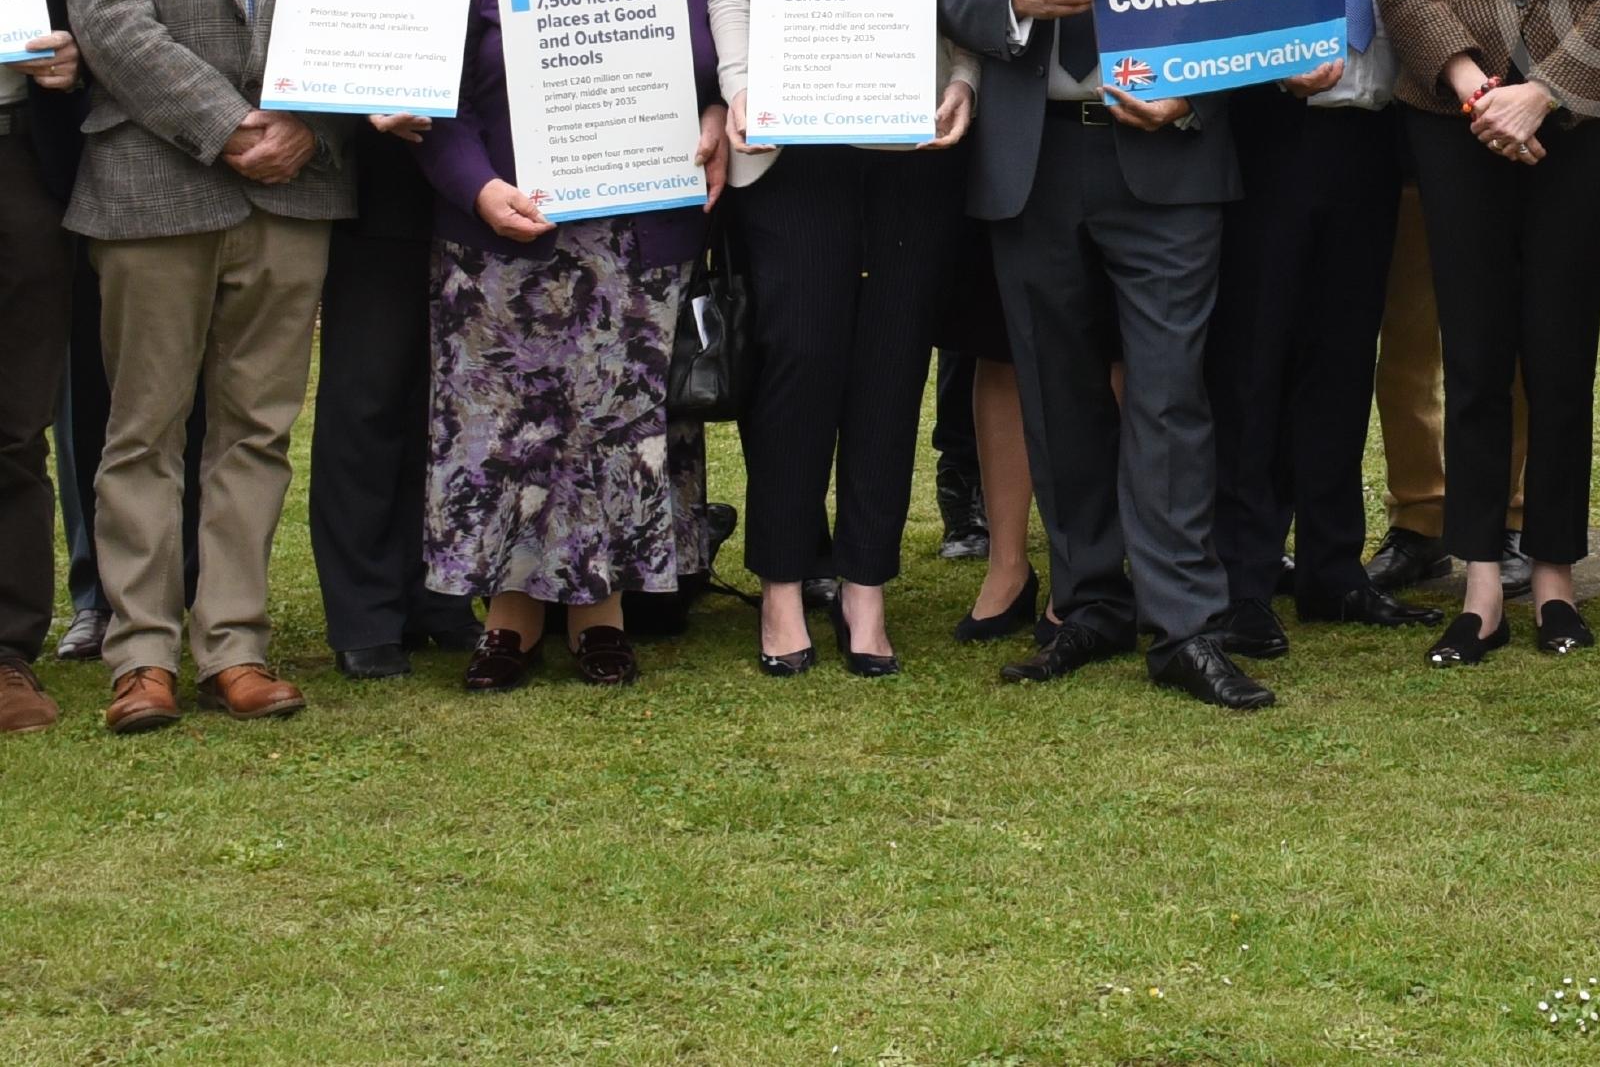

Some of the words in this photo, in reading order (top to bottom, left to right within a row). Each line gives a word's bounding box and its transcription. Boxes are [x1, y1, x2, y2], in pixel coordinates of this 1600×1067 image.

[536, 13, 590, 33] places
[593, 9, 611, 24] at
[614, 4, 657, 22] Good
[539, 32, 570, 49] and
[574, 23, 675, 46] Outstanding
[541, 49, 603, 70] schools
[1162, 37, 1341, 83] Conservatives
[554, 188, 591, 201] Vote
[596, 174, 700, 197] Conservative
